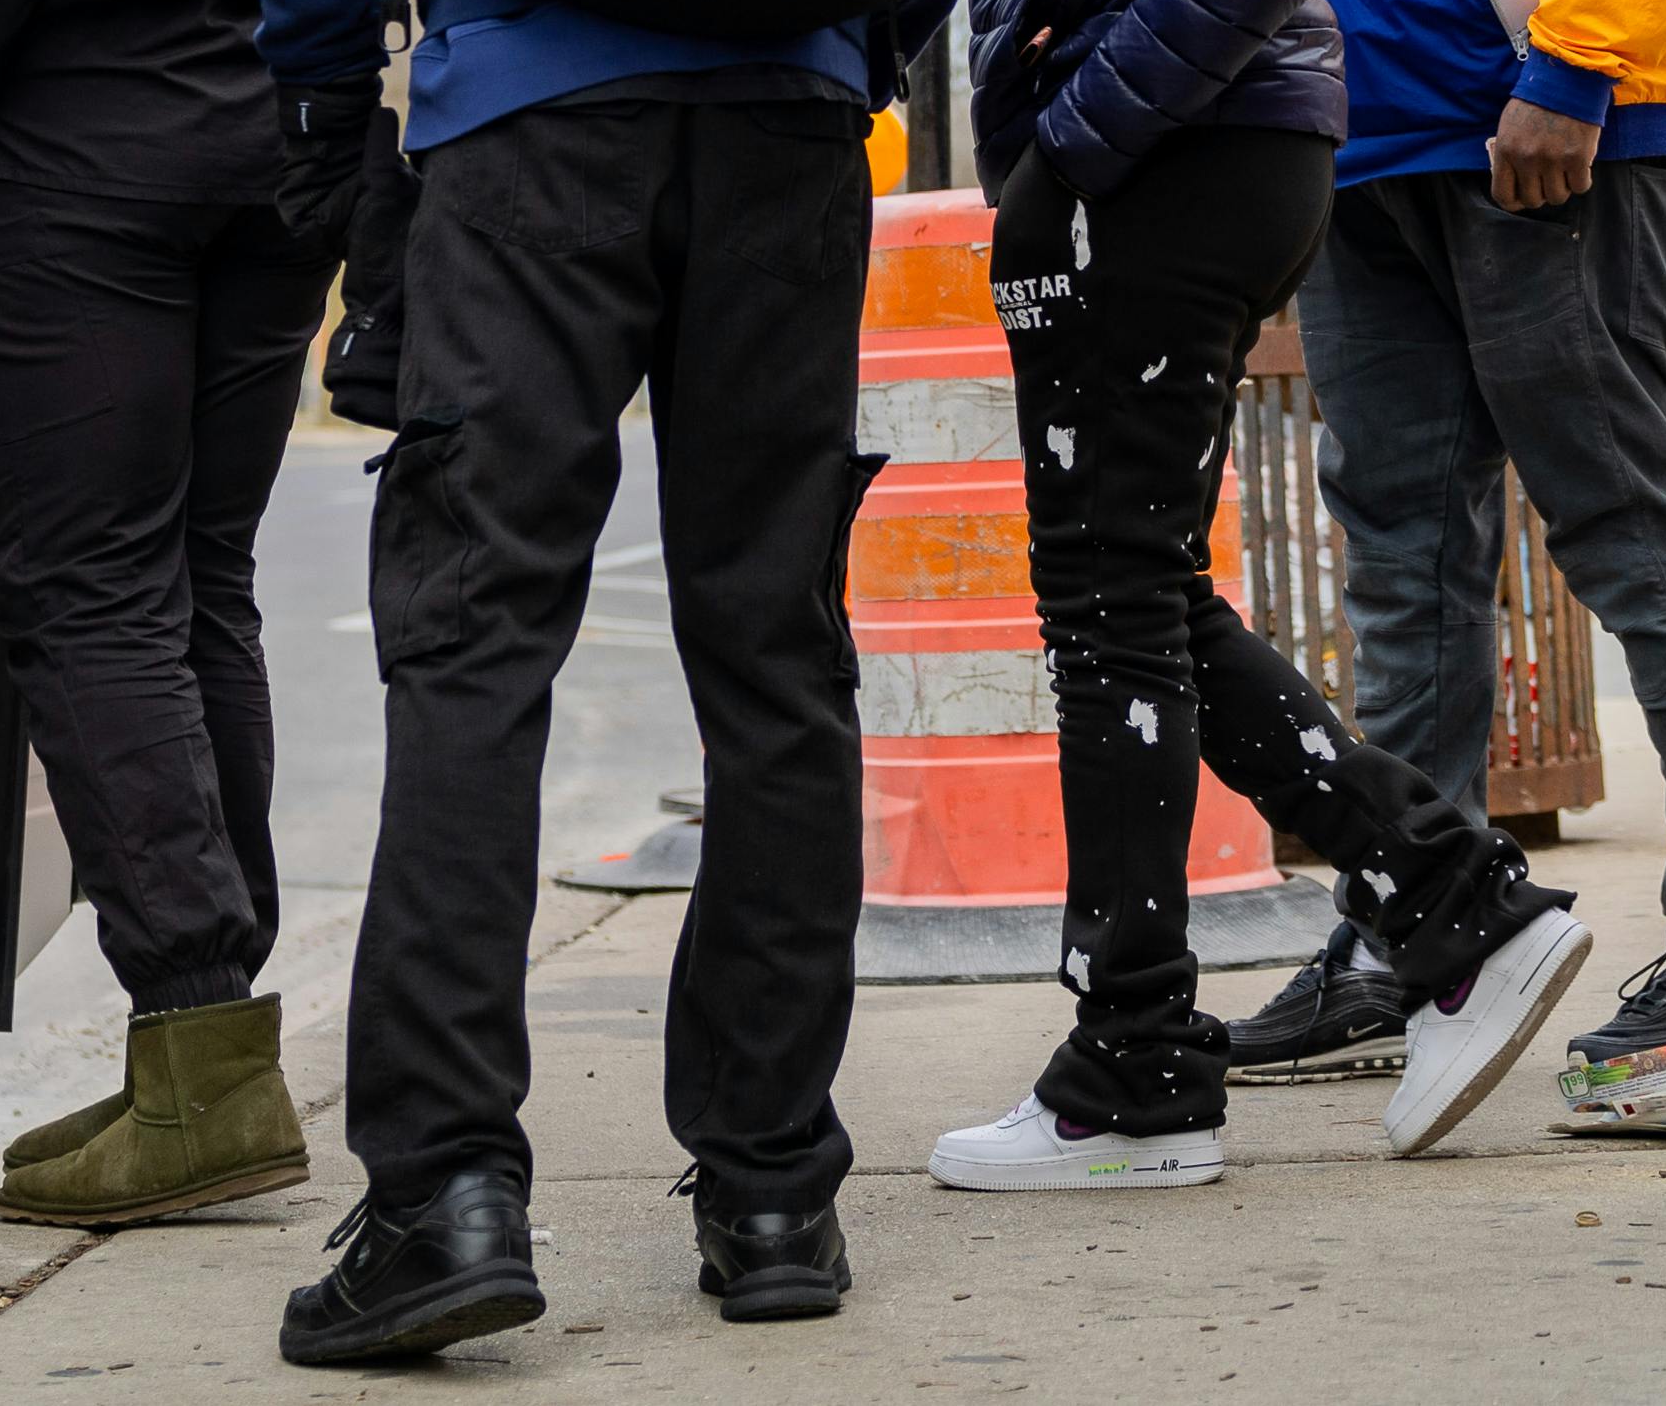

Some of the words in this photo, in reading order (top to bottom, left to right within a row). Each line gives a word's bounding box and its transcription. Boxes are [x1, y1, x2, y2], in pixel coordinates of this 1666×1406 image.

[989, 274, 1071, 305] CKSTAR
[999, 307, 1052, 330] DIST.
[1159, 1159, 1179, 1172] AIR
